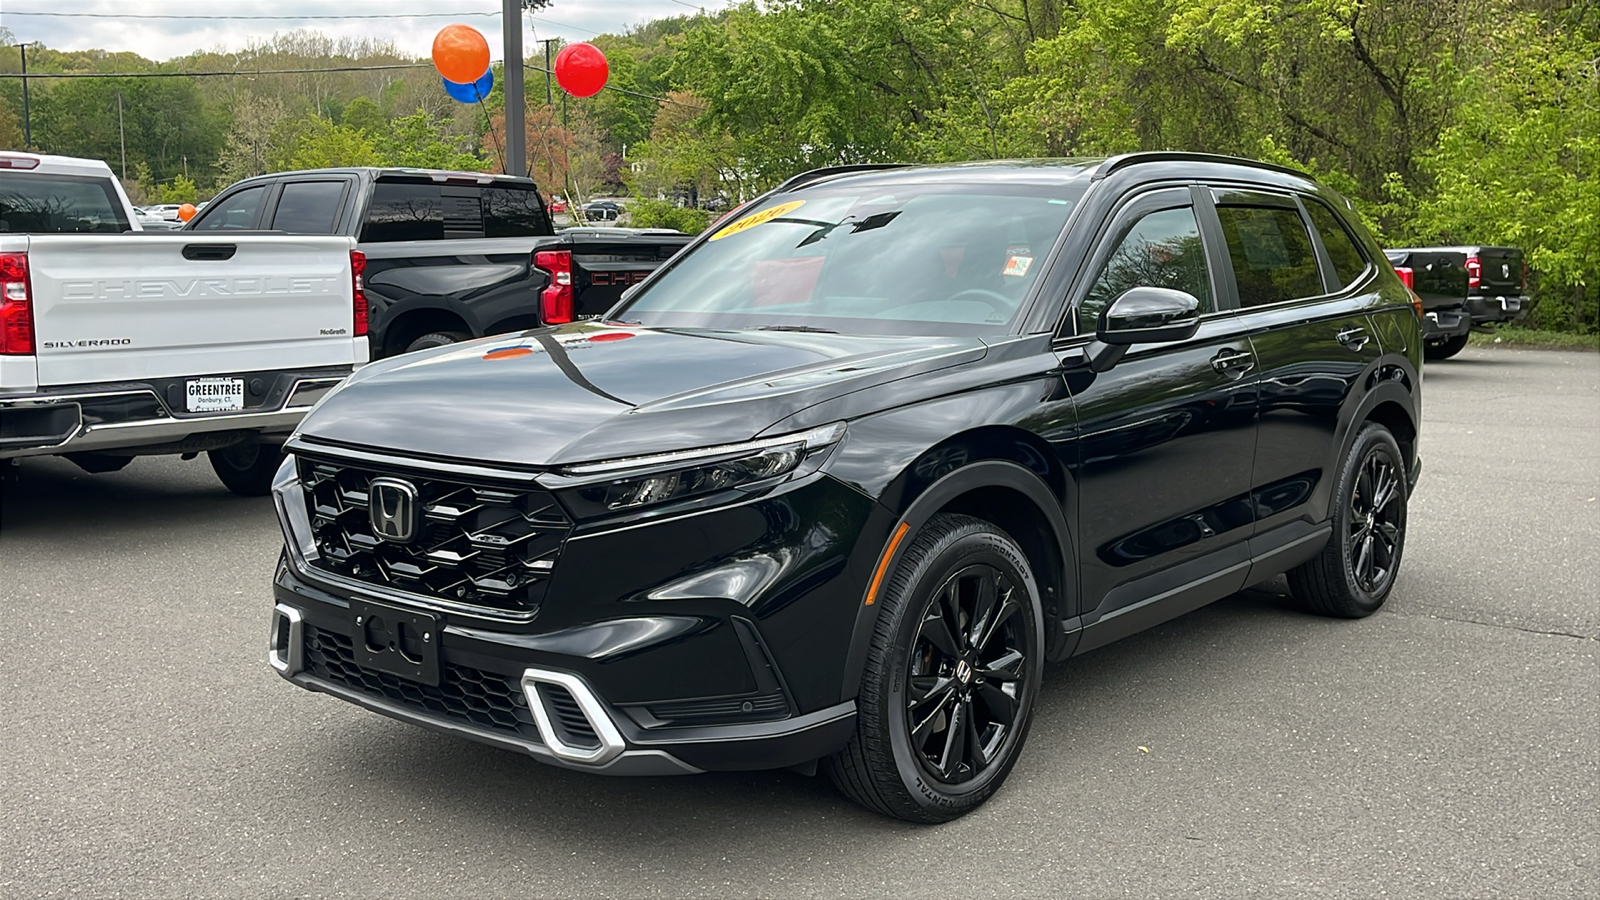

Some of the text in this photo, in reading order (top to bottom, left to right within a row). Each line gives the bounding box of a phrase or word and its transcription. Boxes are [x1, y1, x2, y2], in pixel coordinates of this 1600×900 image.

[61, 276, 337, 300] CHEVROLET
[319, 328, 346, 336] McGrath
[43, 338, 131, 350] SILVERADO
[188, 384, 242, 396] GREENTREE
